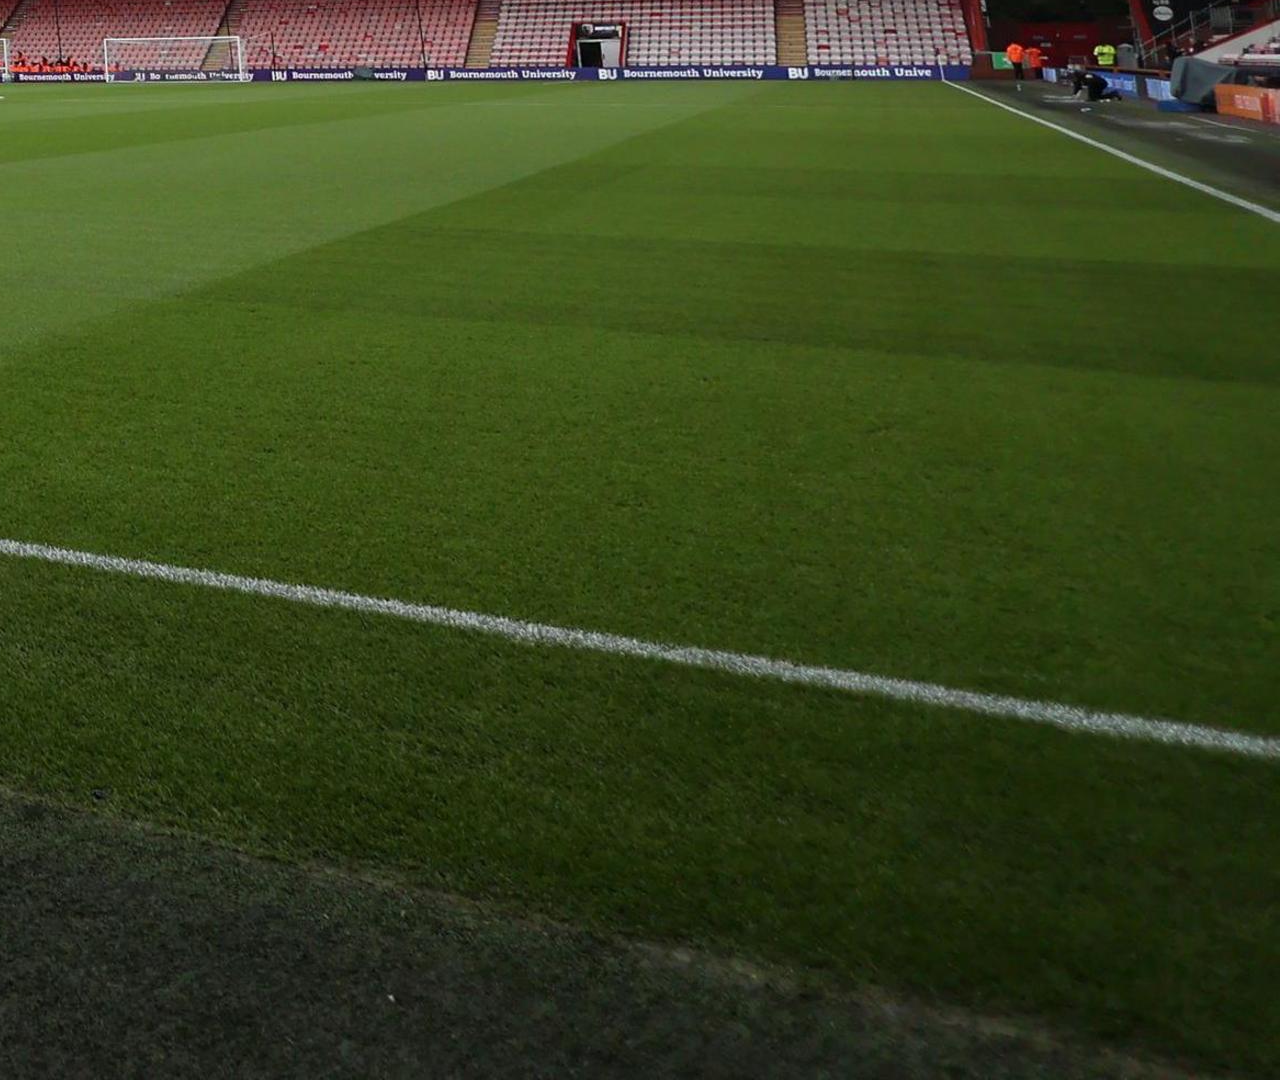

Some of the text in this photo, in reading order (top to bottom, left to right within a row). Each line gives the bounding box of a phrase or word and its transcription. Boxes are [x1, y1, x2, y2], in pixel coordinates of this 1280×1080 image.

[20, 73, 70, 82] Bournemouth
[292, 71, 354, 79] Bournemouth
[427, 69, 576, 80] BU Bournemouth University
[598, 68, 763, 80] BU Bournemouth University
[788, 67, 808, 79] BU
[894, 67, 932, 77] Unive
